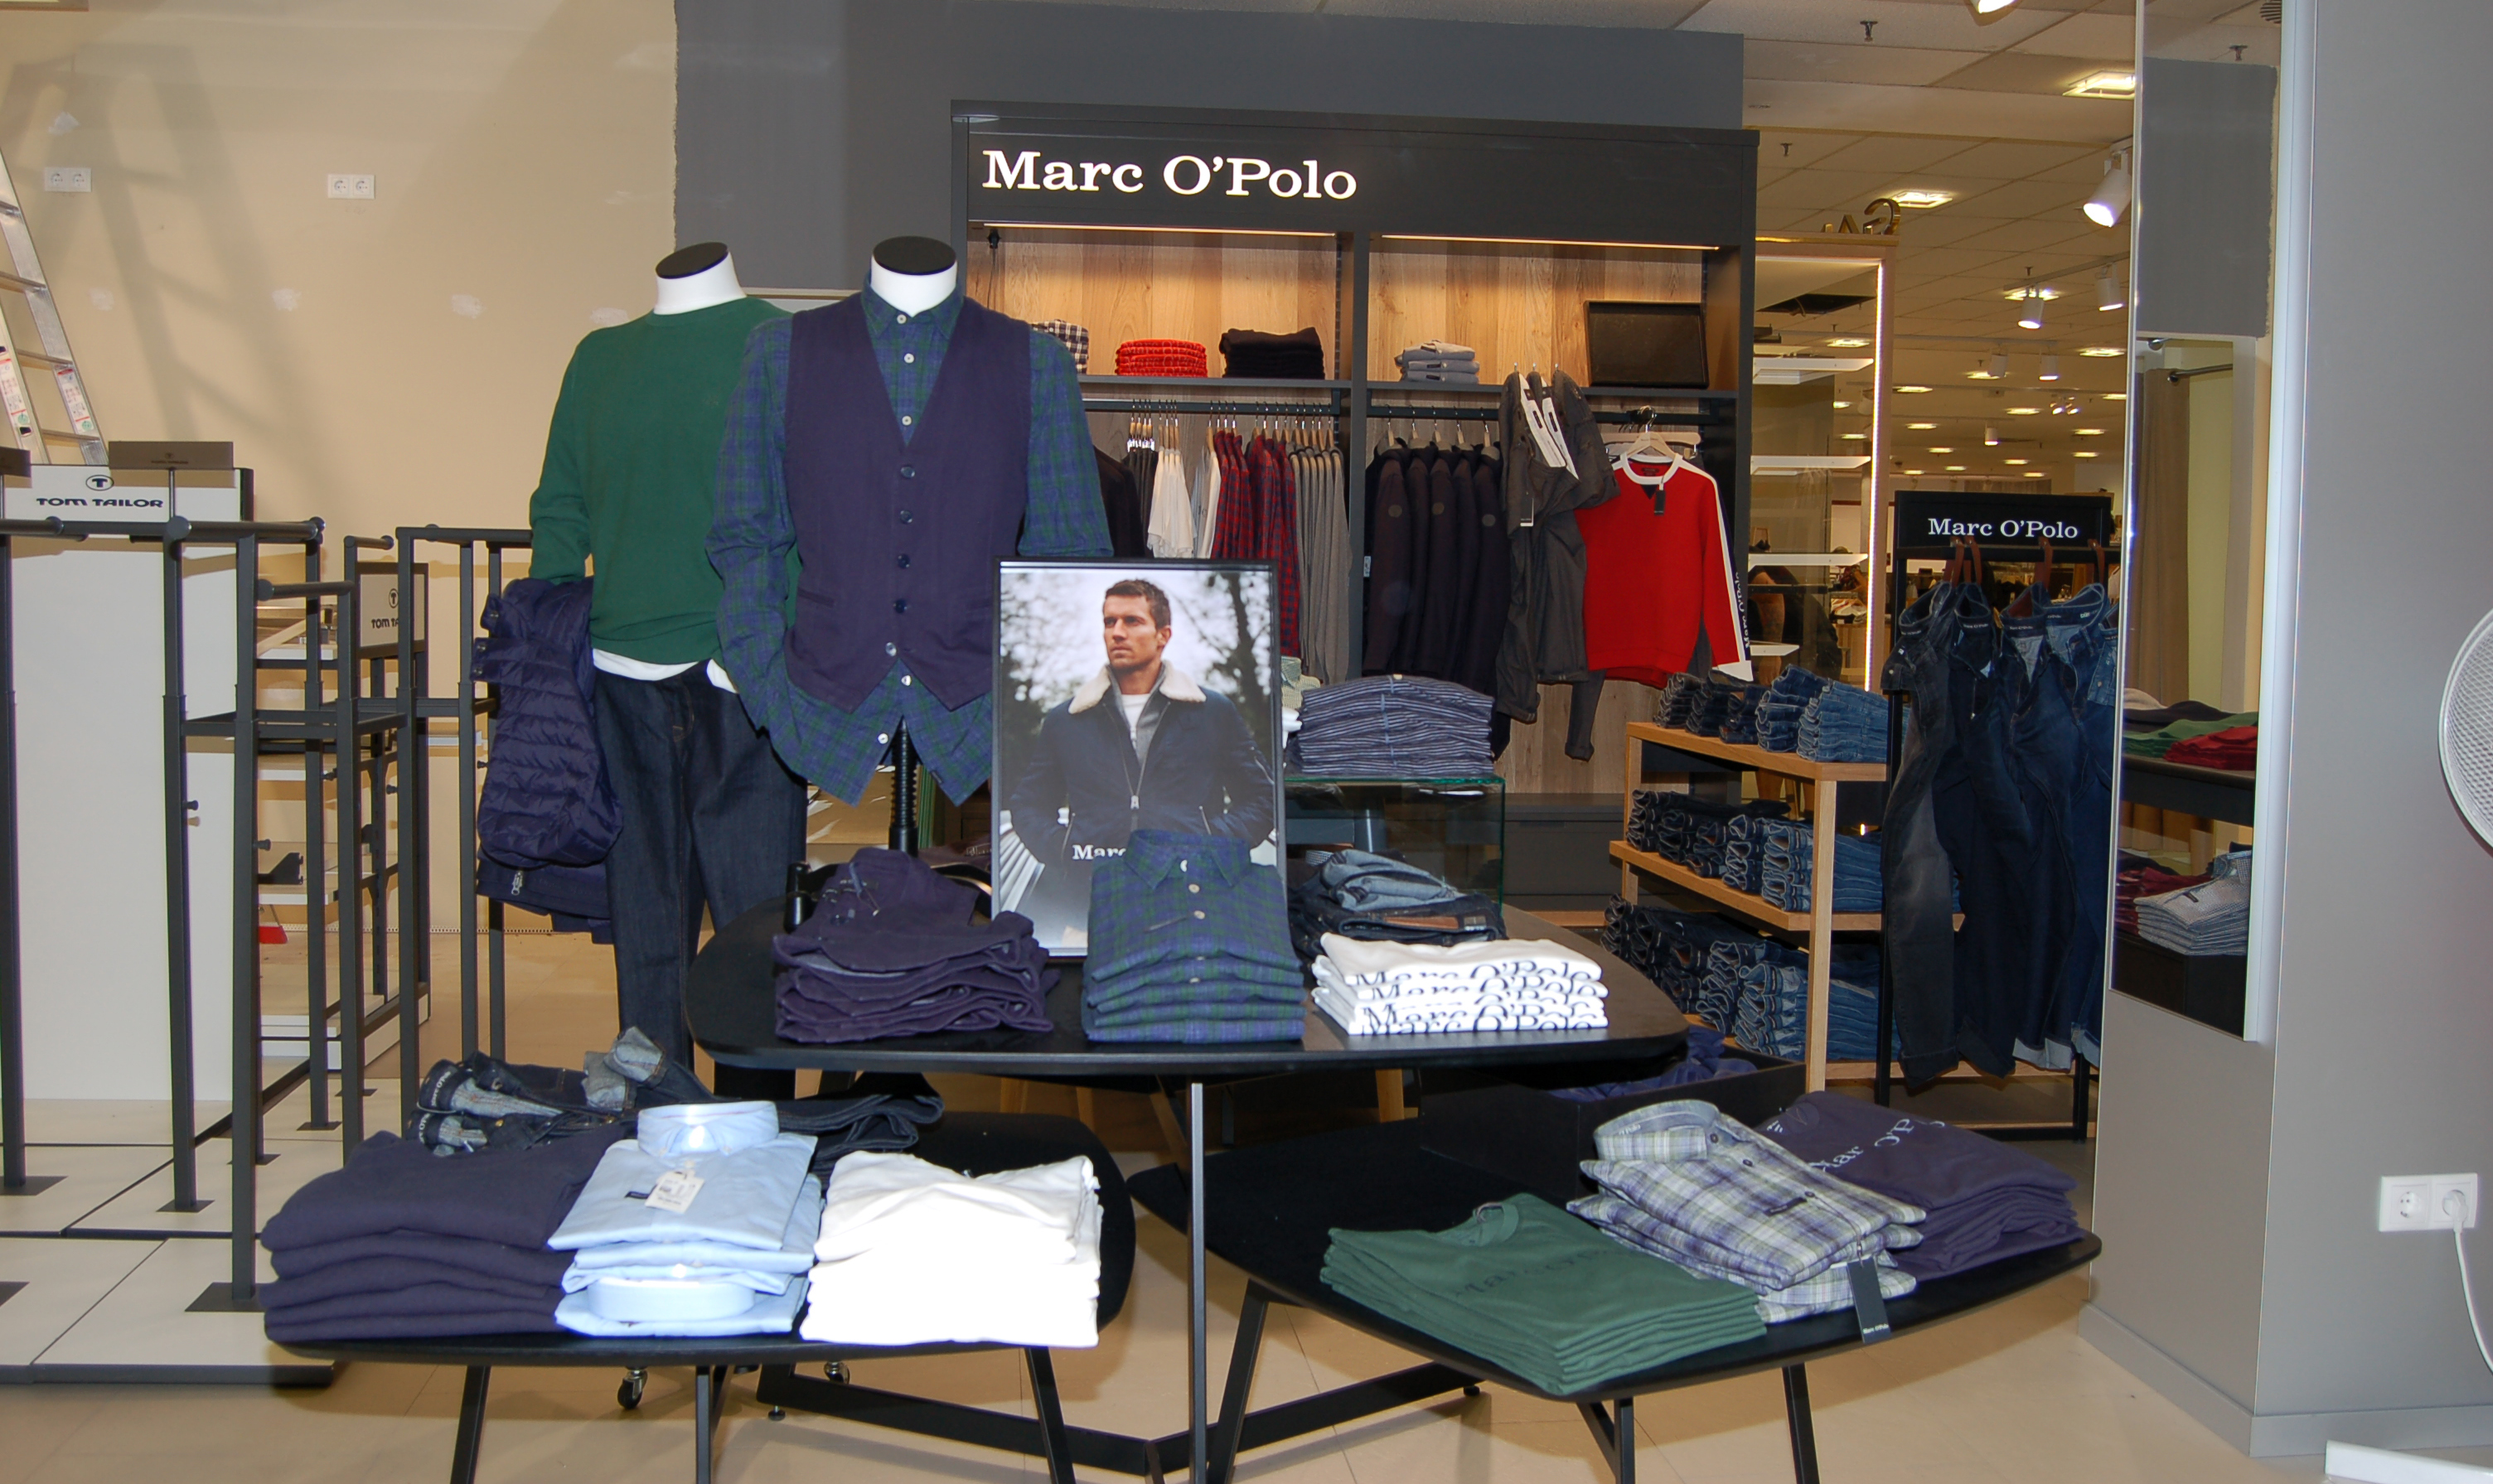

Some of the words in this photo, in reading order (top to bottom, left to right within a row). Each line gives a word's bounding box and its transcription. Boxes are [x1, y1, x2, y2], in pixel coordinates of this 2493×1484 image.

[982, 150, 1144, 193] Marc
[1163, 155, 1358, 200] O'Polo
[36, 497, 88, 507] TOM
[92, 498, 164, 509] TAILOR
[1928, 518, 1992, 536] Marc
[2000, 520, 2079, 539] O'Polo
[371, 618, 390, 629] TOM
